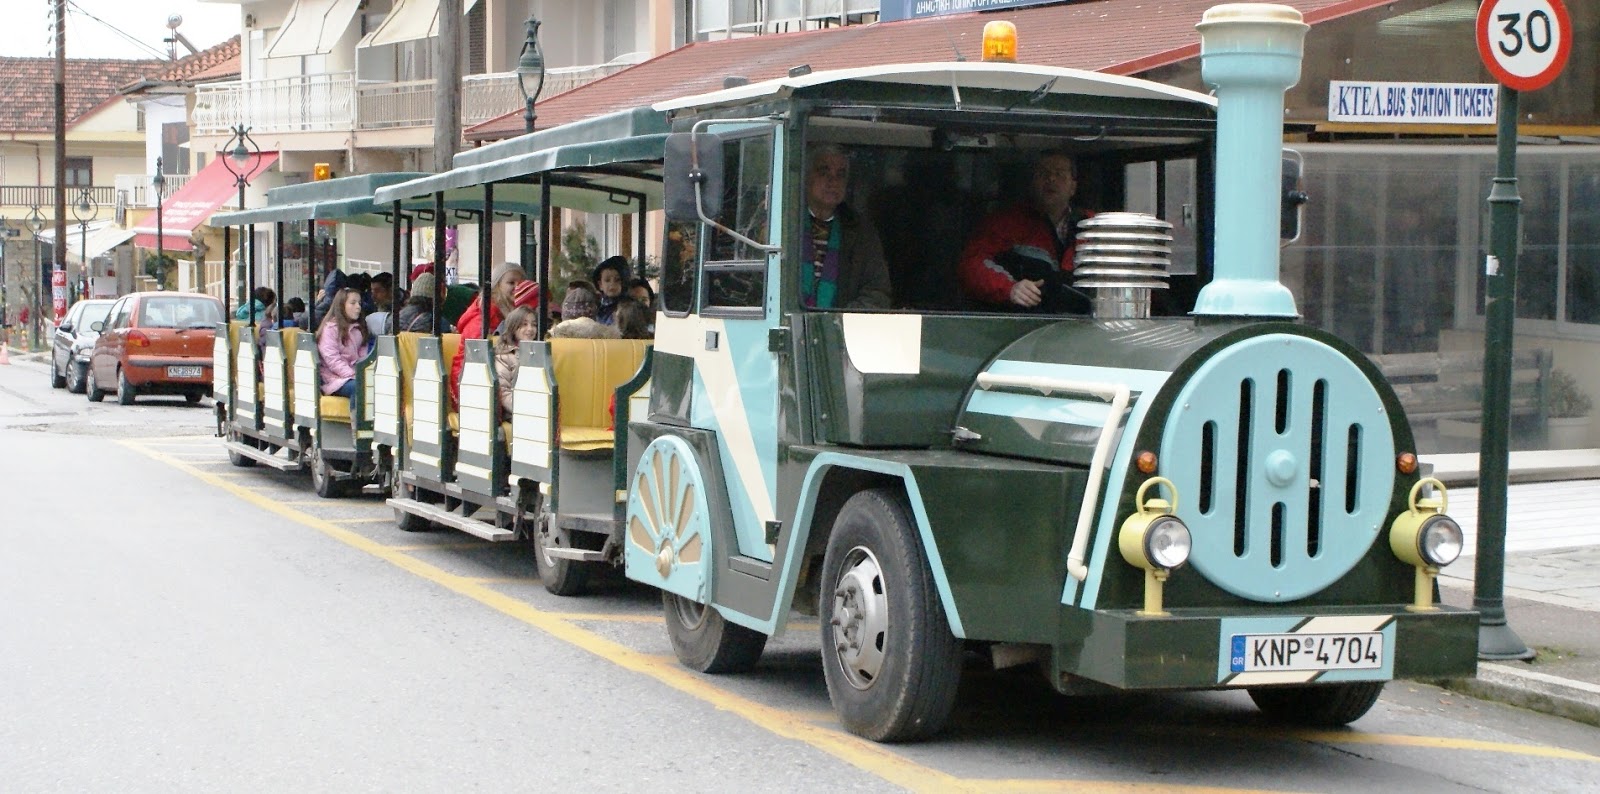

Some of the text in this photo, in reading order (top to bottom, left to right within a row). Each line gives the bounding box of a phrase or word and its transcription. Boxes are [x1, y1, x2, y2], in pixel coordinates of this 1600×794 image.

[1497, 9, 1551, 57] 30
[1410, 87, 1451, 118] STATION
[1454, 88, 1494, 118] TICKETS
[1232, 656, 1244, 666] GR
[1253, 636, 1377, 667] KNP-4704
